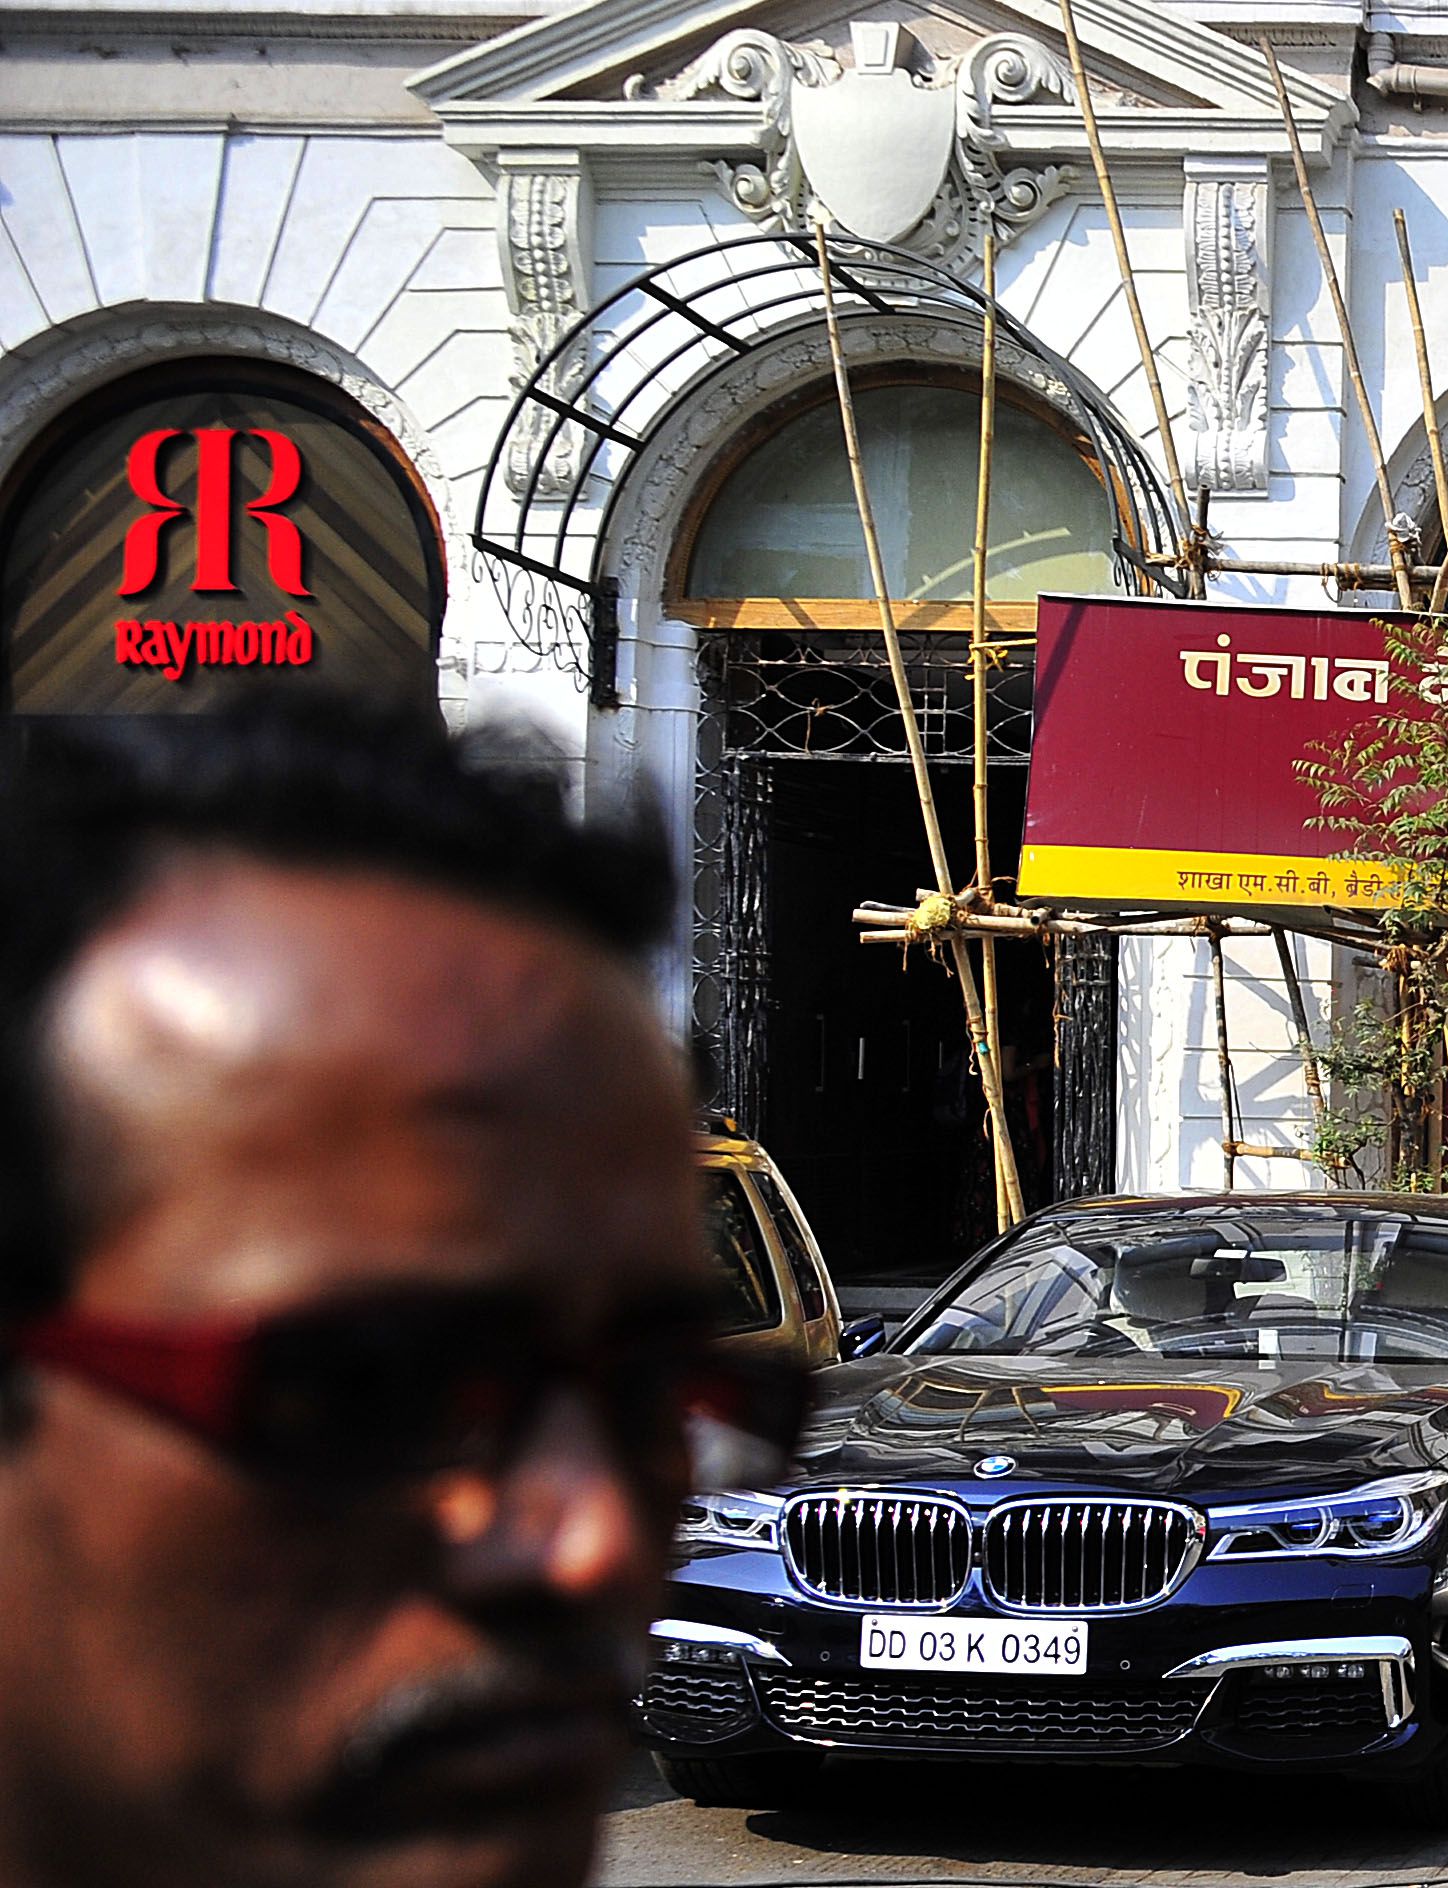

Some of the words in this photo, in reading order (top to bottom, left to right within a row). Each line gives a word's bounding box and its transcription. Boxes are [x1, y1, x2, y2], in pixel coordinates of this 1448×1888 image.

[114, 610, 313, 682] Raymond
[1180, 633, 1389, 704] पंजाब
[1177, 870, 1233, 891] शाखा
[868, 1629, 907, 1659] DD
[919, 1631, 955, 1662] 03
[967, 1633, 985, 1663] K
[1001, 1633, 1081, 1665] 0349
